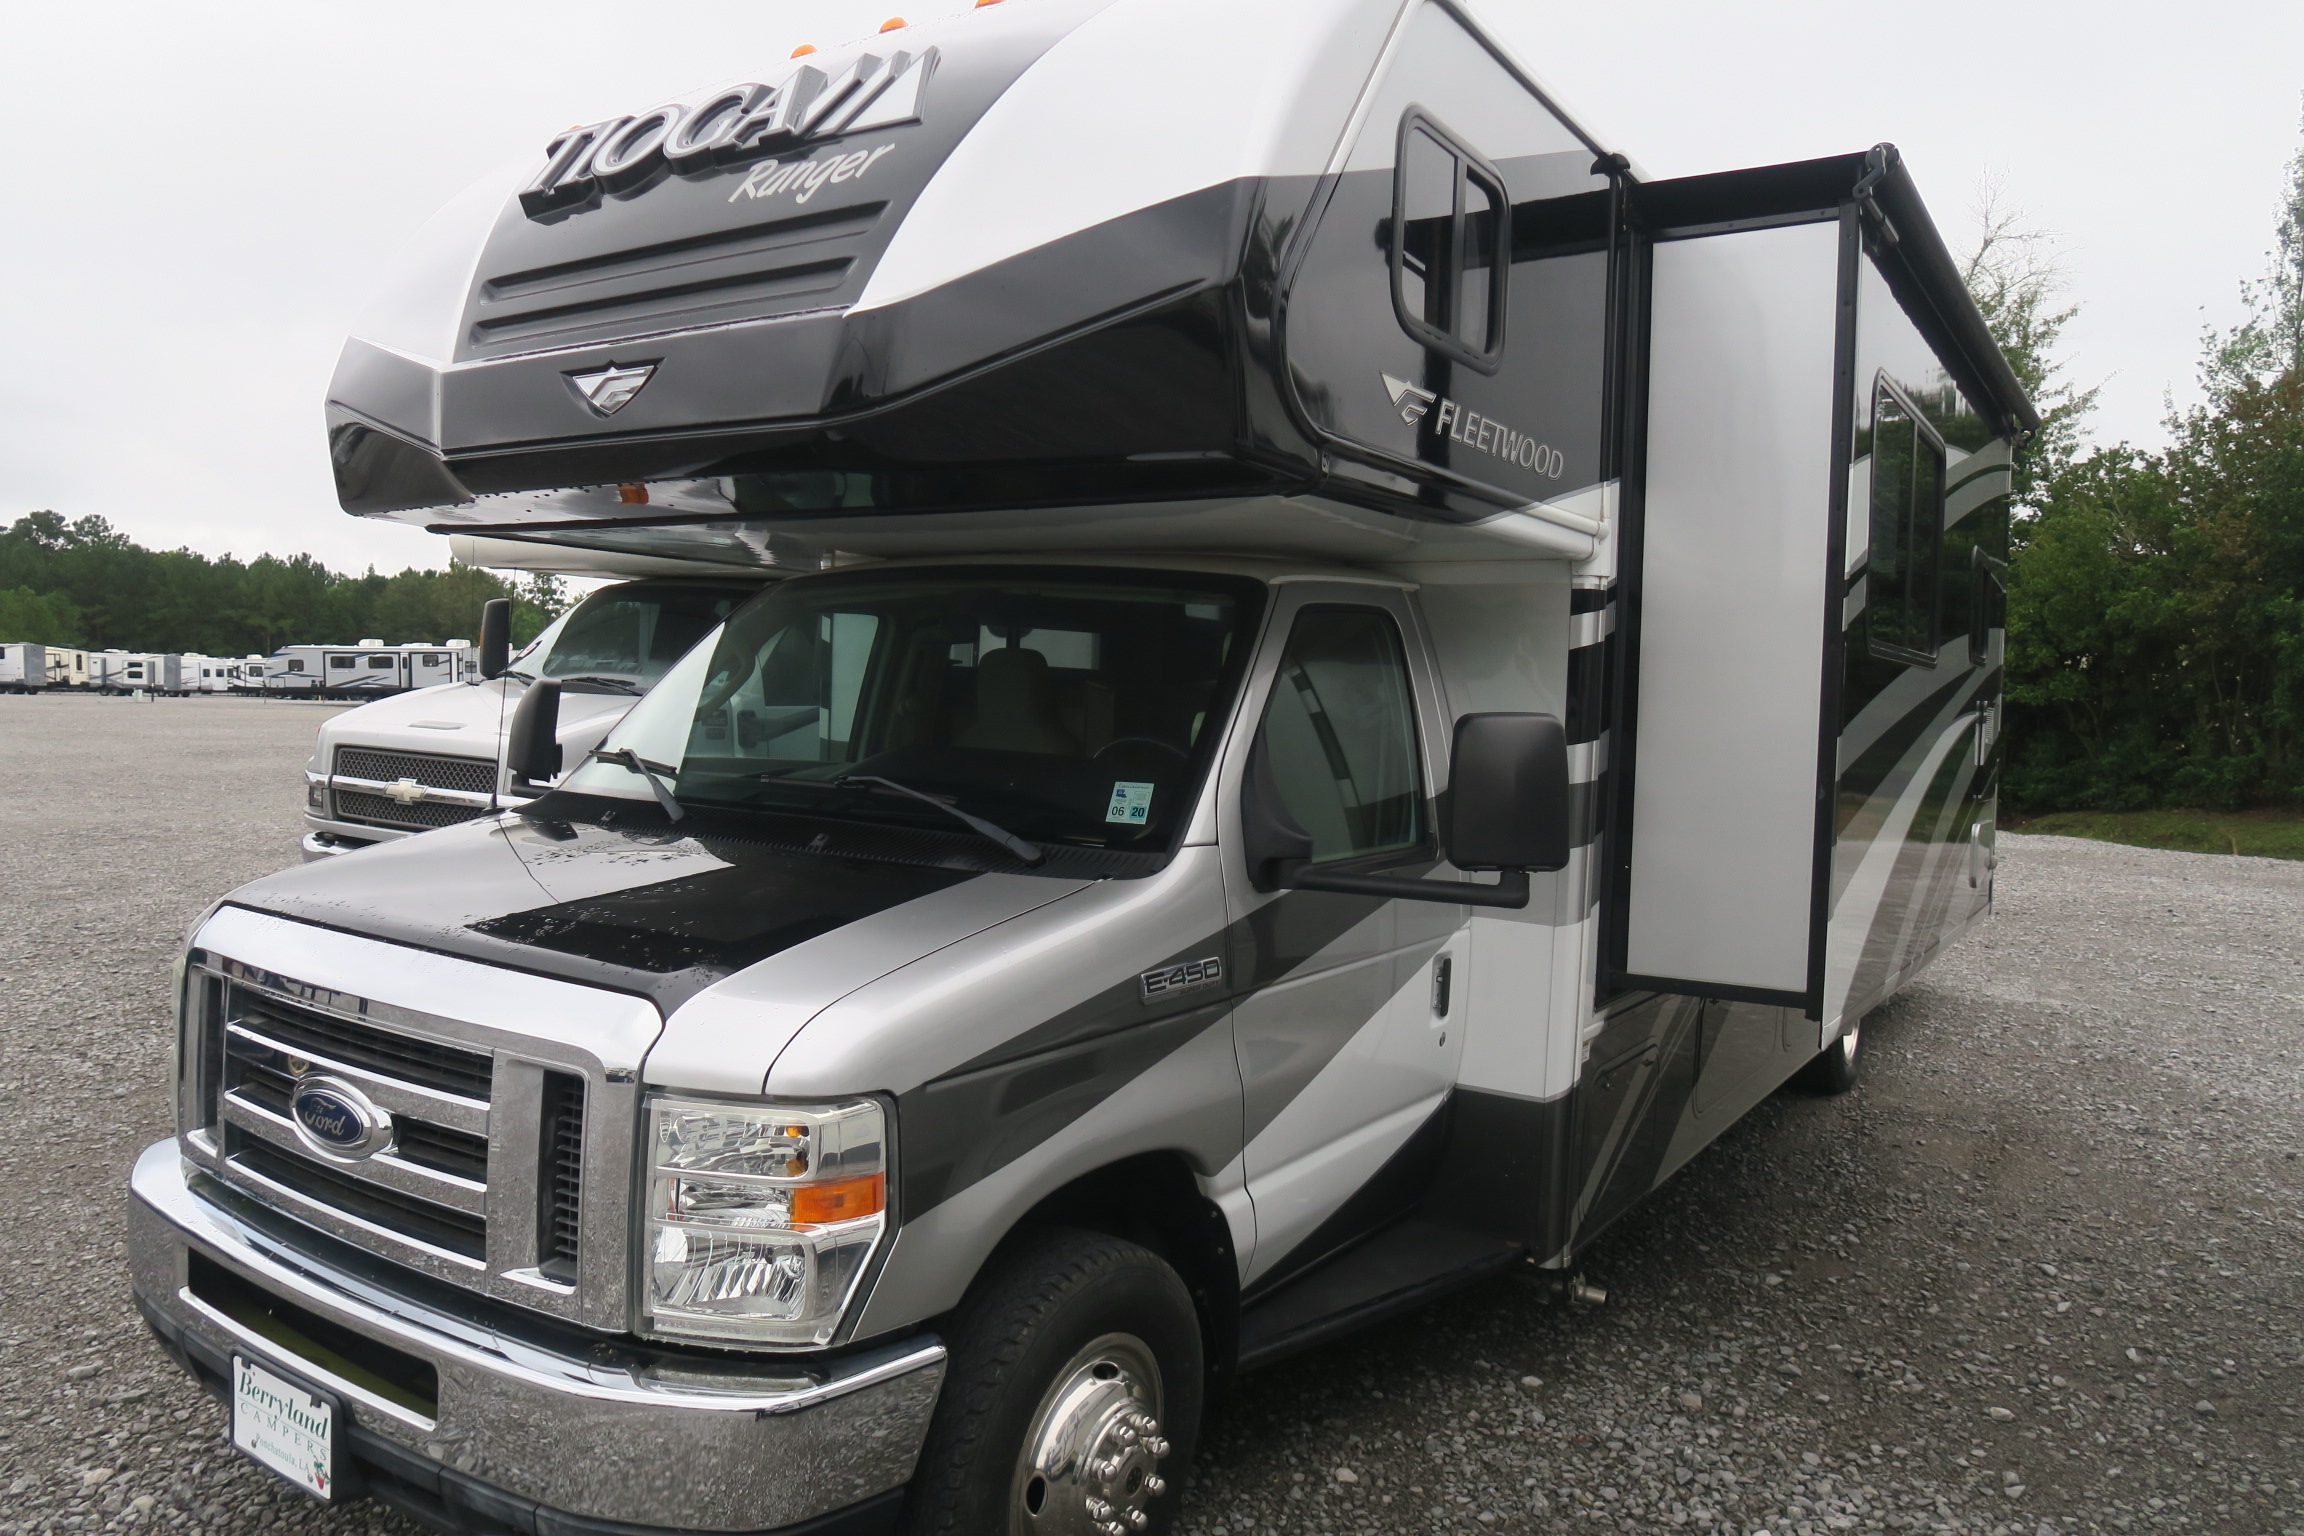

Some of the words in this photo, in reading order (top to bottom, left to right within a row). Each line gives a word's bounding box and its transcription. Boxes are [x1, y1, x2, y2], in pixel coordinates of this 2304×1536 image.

[519, 64, 828, 216] TIOGA
[728, 141, 896, 204] Ranger
[1434, 397, 1564, 481] FLEETWOOD
[1111, 805, 1125, 817] 06
[1131, 806, 1145, 818] 20
[1145, 958, 1220, 994] E-450
[304, 1097, 346, 1136] Ford
[239, 1371, 329, 1441] Berryland
[240, 1402, 328, 1462] CAMPERS
